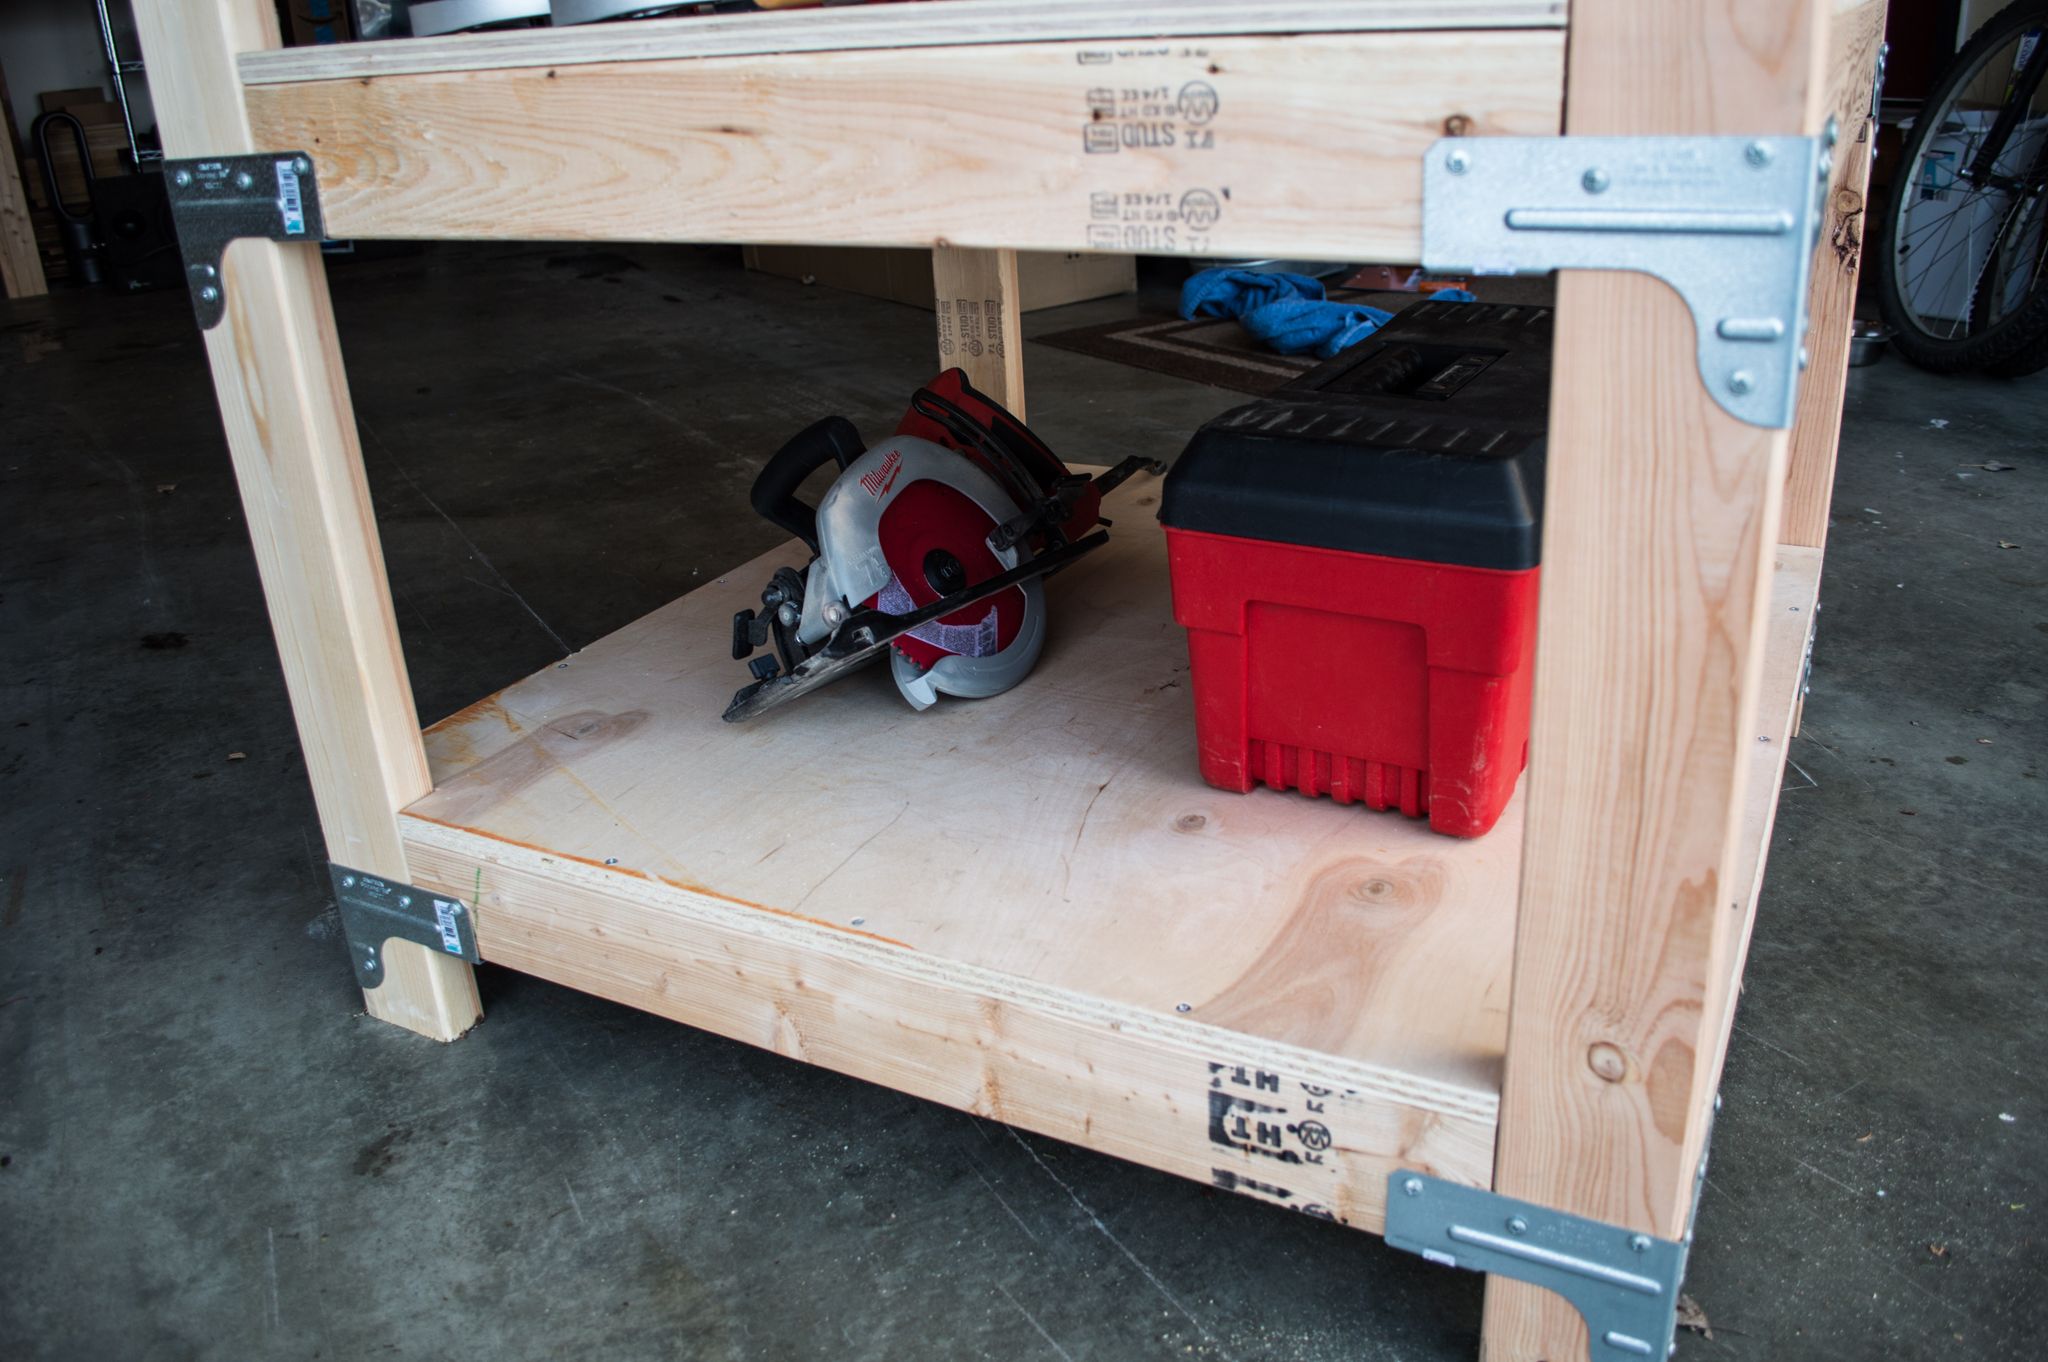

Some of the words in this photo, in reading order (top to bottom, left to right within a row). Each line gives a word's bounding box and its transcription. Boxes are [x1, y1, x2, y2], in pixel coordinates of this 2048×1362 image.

[1122, 123, 1175, 148] STUD
[1124, 225, 1176, 251] STUD
[960, 315, 970, 338] STUD
[987, 317, 997, 339] STUD
[859, 448, 901, 496] Milwaukee
[1231, 1116, 1282, 1148] HT
